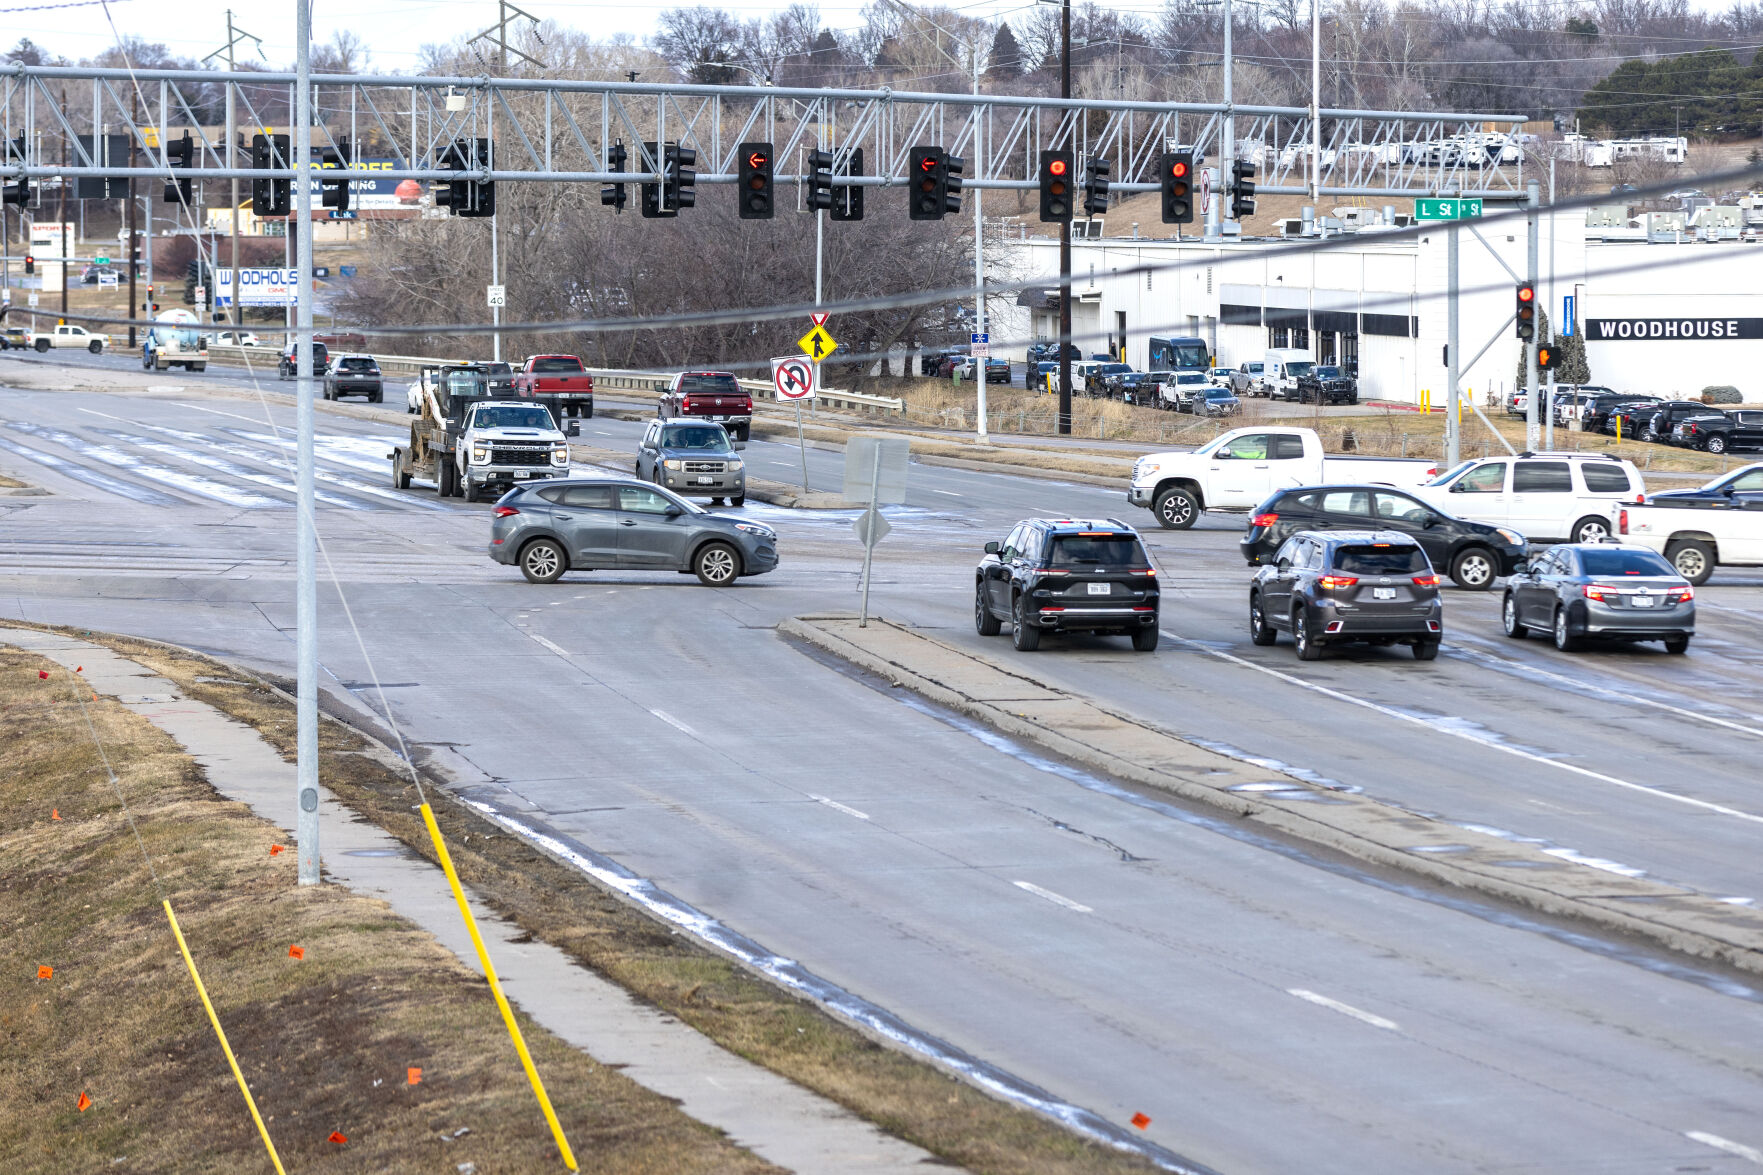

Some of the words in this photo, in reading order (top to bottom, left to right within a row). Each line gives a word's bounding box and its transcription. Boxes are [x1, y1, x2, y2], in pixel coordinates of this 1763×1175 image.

[1422, 203, 1431, 216] L
[1439, 203, 1452, 216] St
[1470, 203, 1480, 216] St
[220, 270, 298, 285] WODHOUS
[490, 296, 503, 304] 40
[1599, 321, 1739, 338] WOODHOUSE
